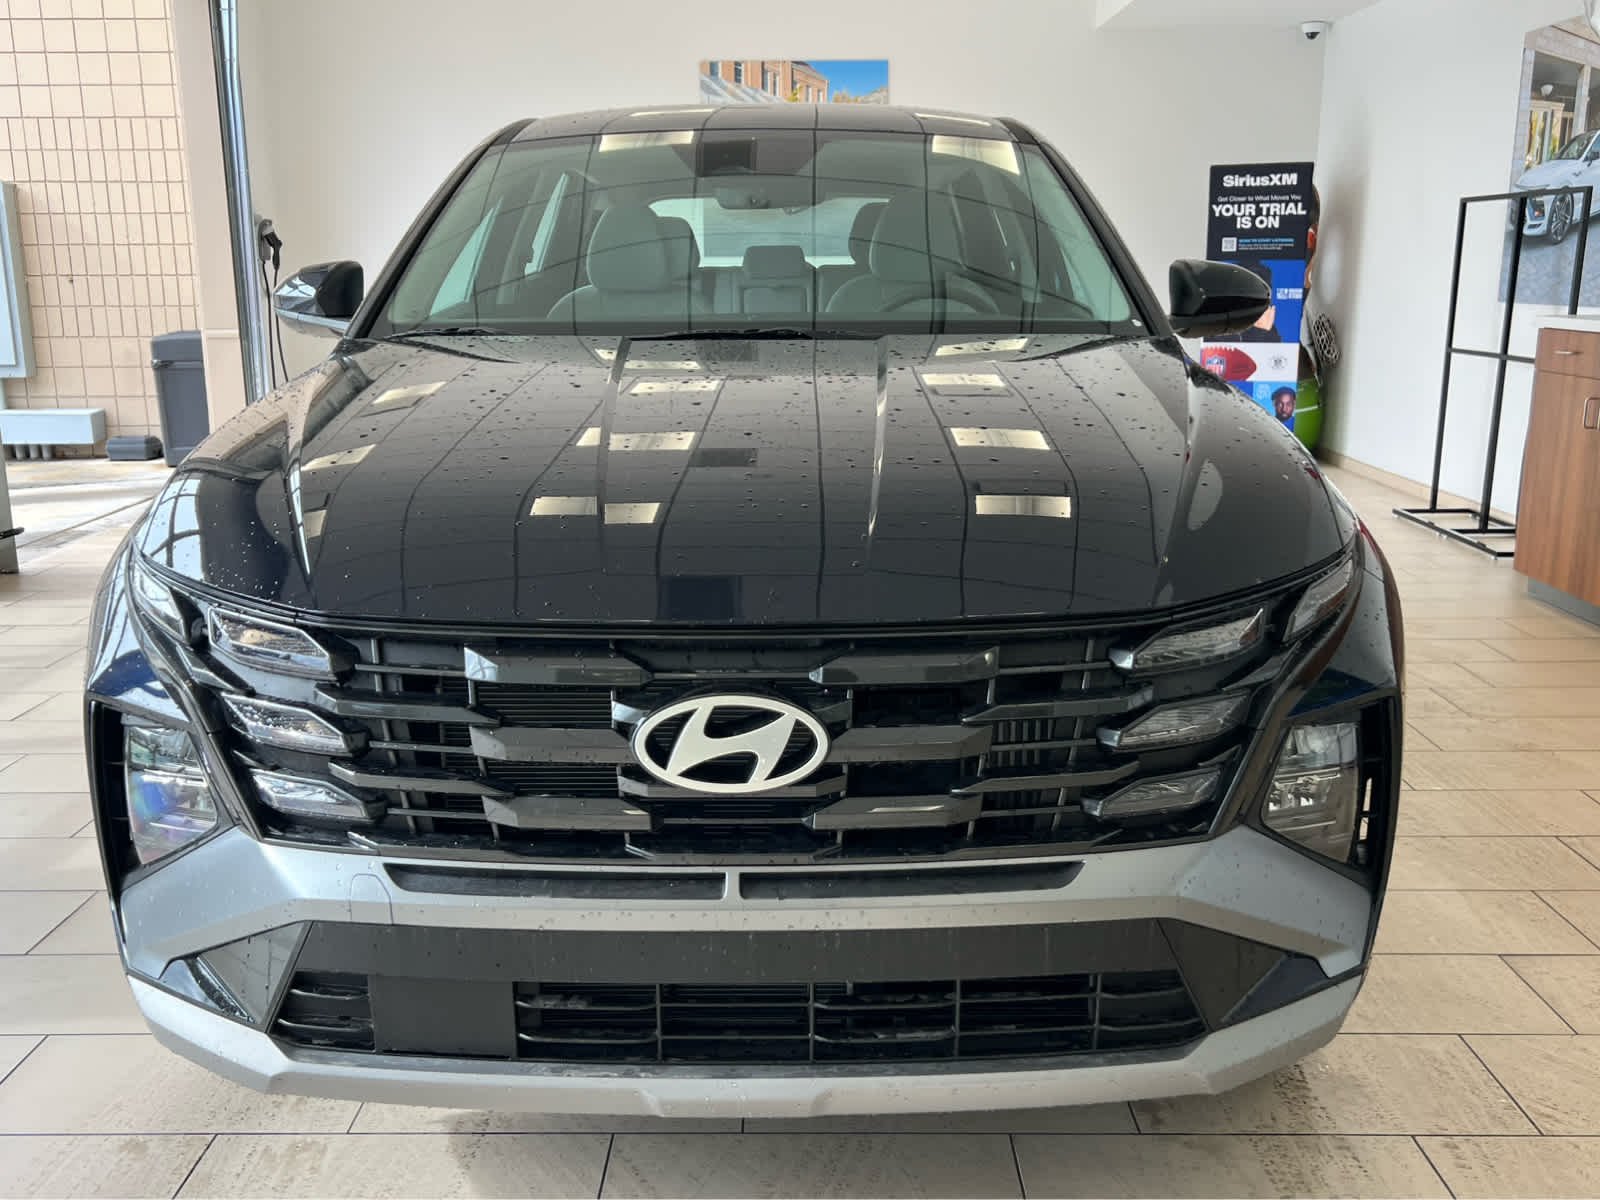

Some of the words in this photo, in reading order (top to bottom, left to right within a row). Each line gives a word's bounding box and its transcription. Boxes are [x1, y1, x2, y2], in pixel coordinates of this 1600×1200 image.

[1223, 173, 1298, 187] SiriusXM
[1212, 203, 1256, 217] YOUR
[1259, 202, 1307, 216] TRIAL
[1236, 217, 1252, 229] IS
[1255, 216, 1280, 228] ON
